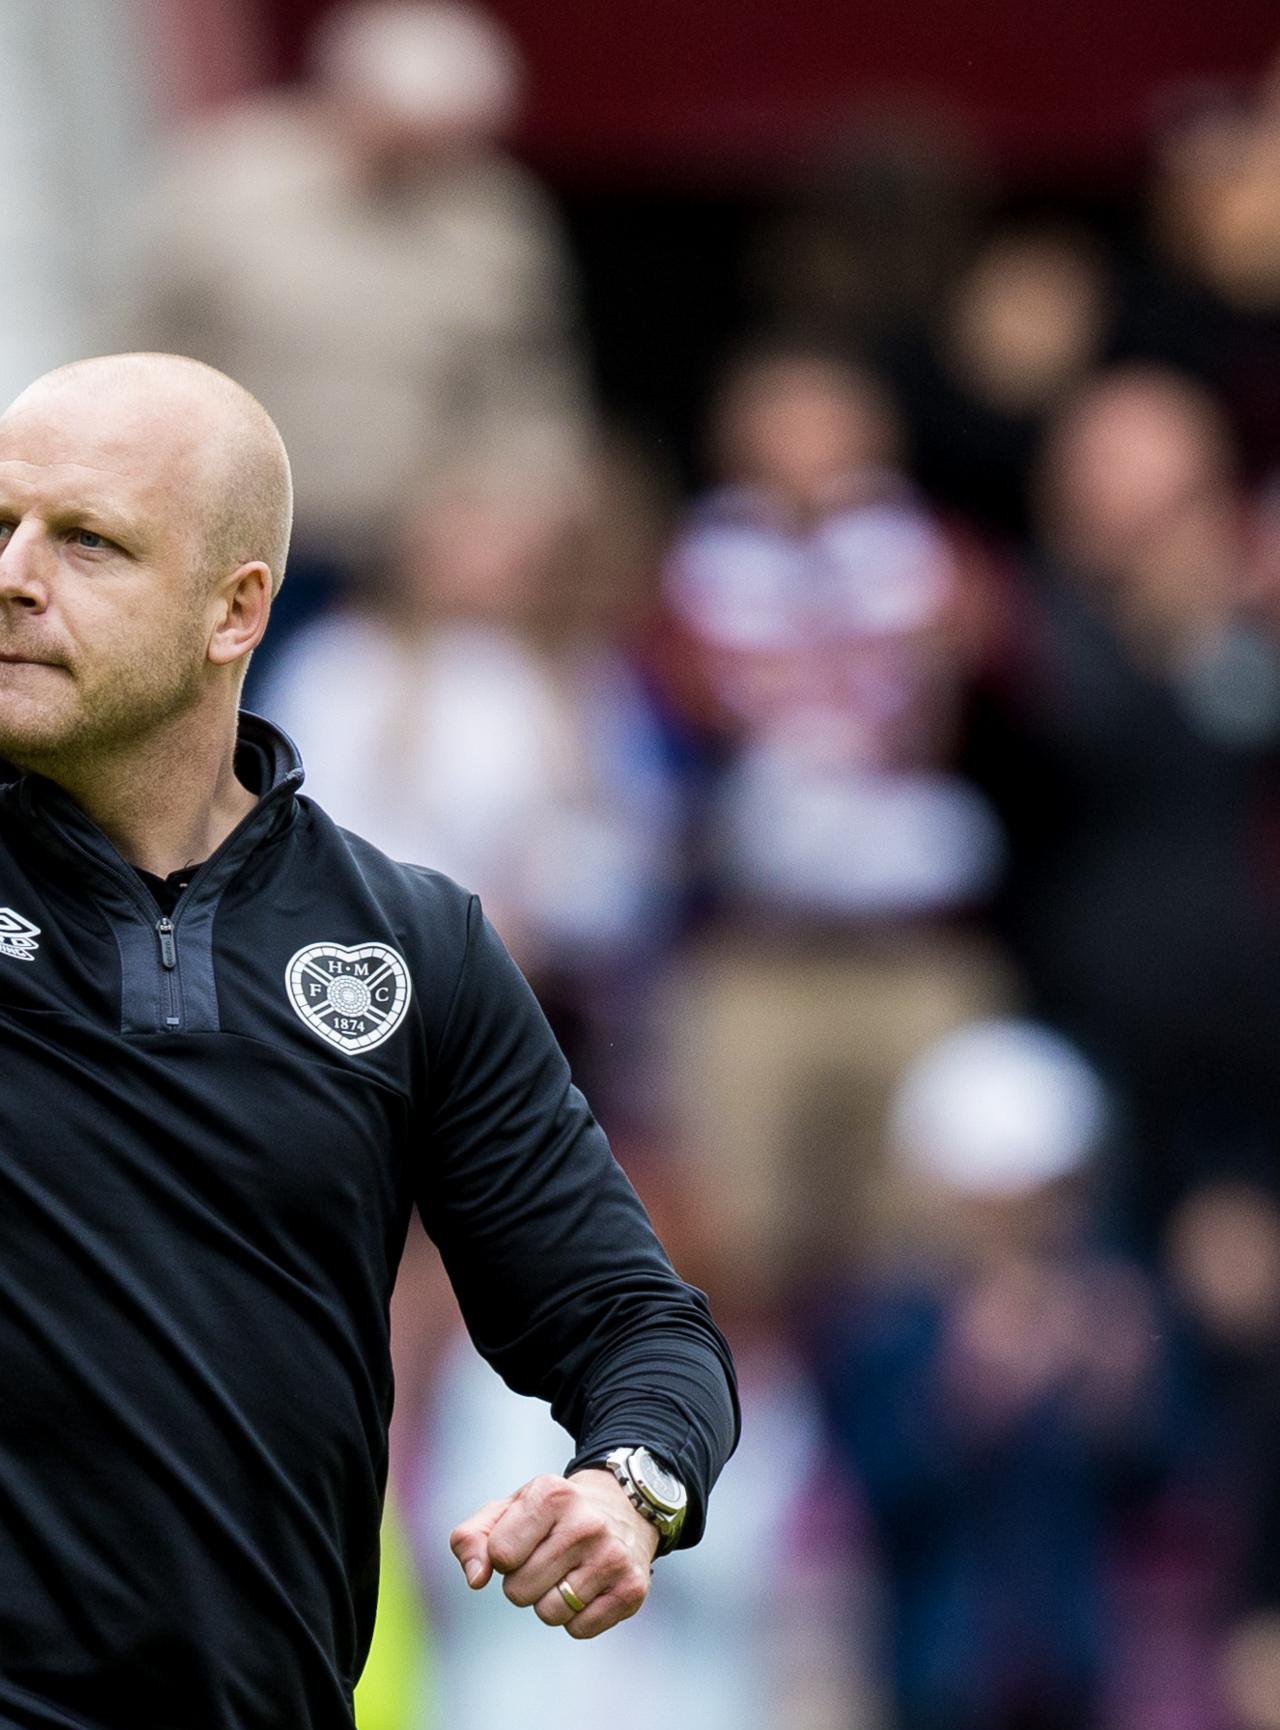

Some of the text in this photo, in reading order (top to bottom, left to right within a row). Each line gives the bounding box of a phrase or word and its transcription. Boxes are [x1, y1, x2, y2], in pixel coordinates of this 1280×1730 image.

[309, 983, 389, 1002] F C
[333, 1017, 366, 1032] 1874
